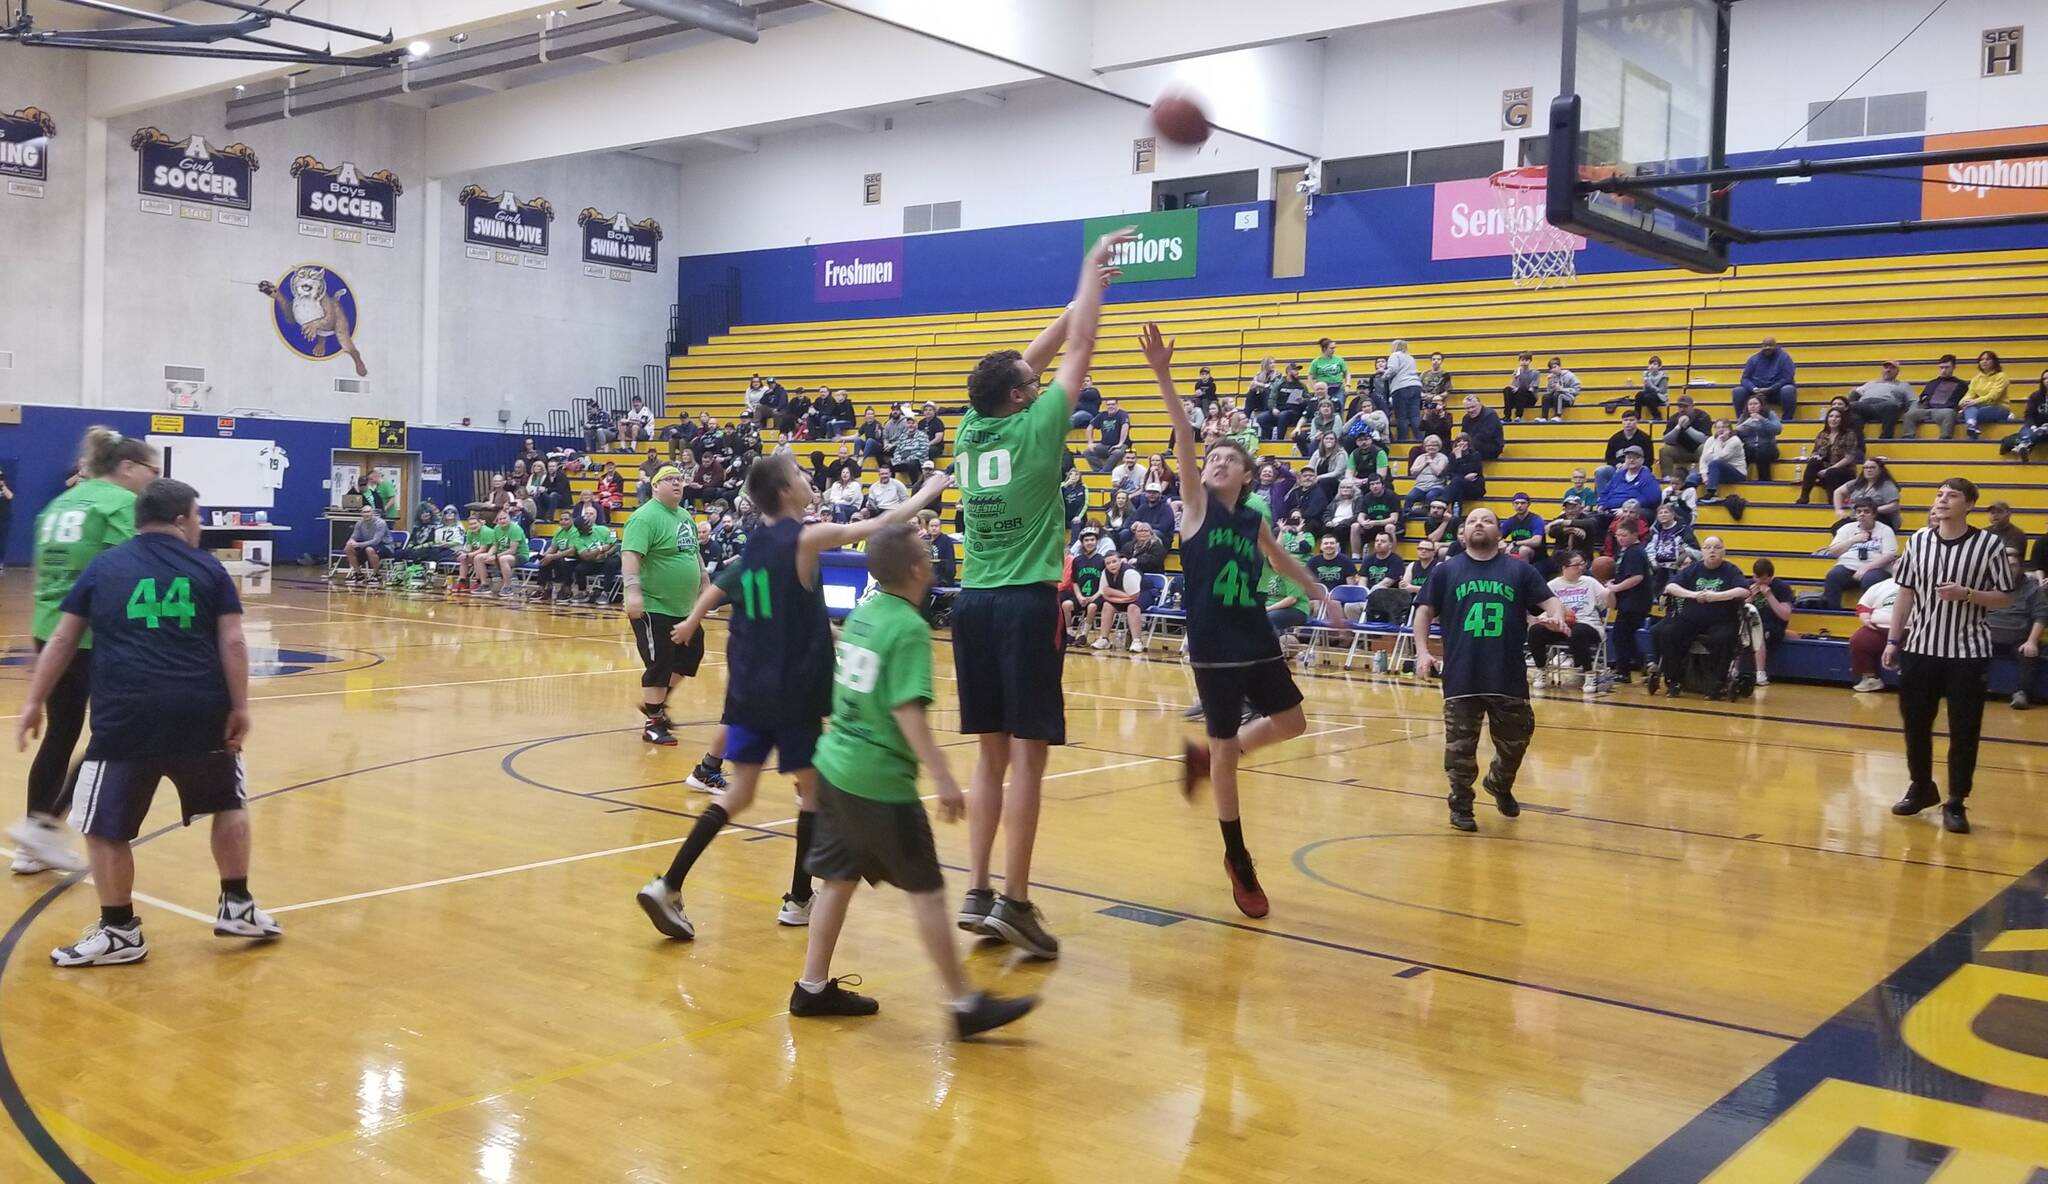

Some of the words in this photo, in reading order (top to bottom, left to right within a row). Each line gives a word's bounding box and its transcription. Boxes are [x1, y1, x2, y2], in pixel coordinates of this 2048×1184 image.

[1985, 31, 2019, 43] SEC
[1985, 43, 2017, 75] H
[1504, 90, 1529, 102] SEC
[1504, 102, 1528, 127] G
[0, 141, 39, 168] ING
[1135, 140, 1154, 150] SEC
[179, 157, 215, 174] Girls
[1135, 150, 1152, 172] F
[153, 164, 238, 197] SOCCER
[329, 182, 366, 197] Boys
[864, 174, 881, 184] SEC
[1946, 159, 2048, 198] Sophom
[310, 191, 384, 220] SOCCER
[866, 184, 880, 203] E
[494, 210, 522, 225] Girls
[1450, 198, 1547, 239] Senior
[472, 216, 507, 240] SWIM
[507, 223, 516, 239] &
[515, 223, 543, 245] DIVE
[607, 230, 635, 243] Boys
[590, 237, 620, 258] SWIM
[620, 243, 628, 259] &
[627, 243, 652, 263] DIVE
[1107, 233, 1184, 267] uniors
[824, 257, 894, 288] Freshmen
[269, 458, 279, 470] 19
[953, 448, 1012, 488] 10
[442, 529, 454, 542] 12
[741, 567, 773, 619] 11
[1081, 579, 1092, 596] 4
[1455, 579, 1515, 602] HAWKS
[126, 576, 195, 629] 44
[1463, 602, 1504, 638] 43
